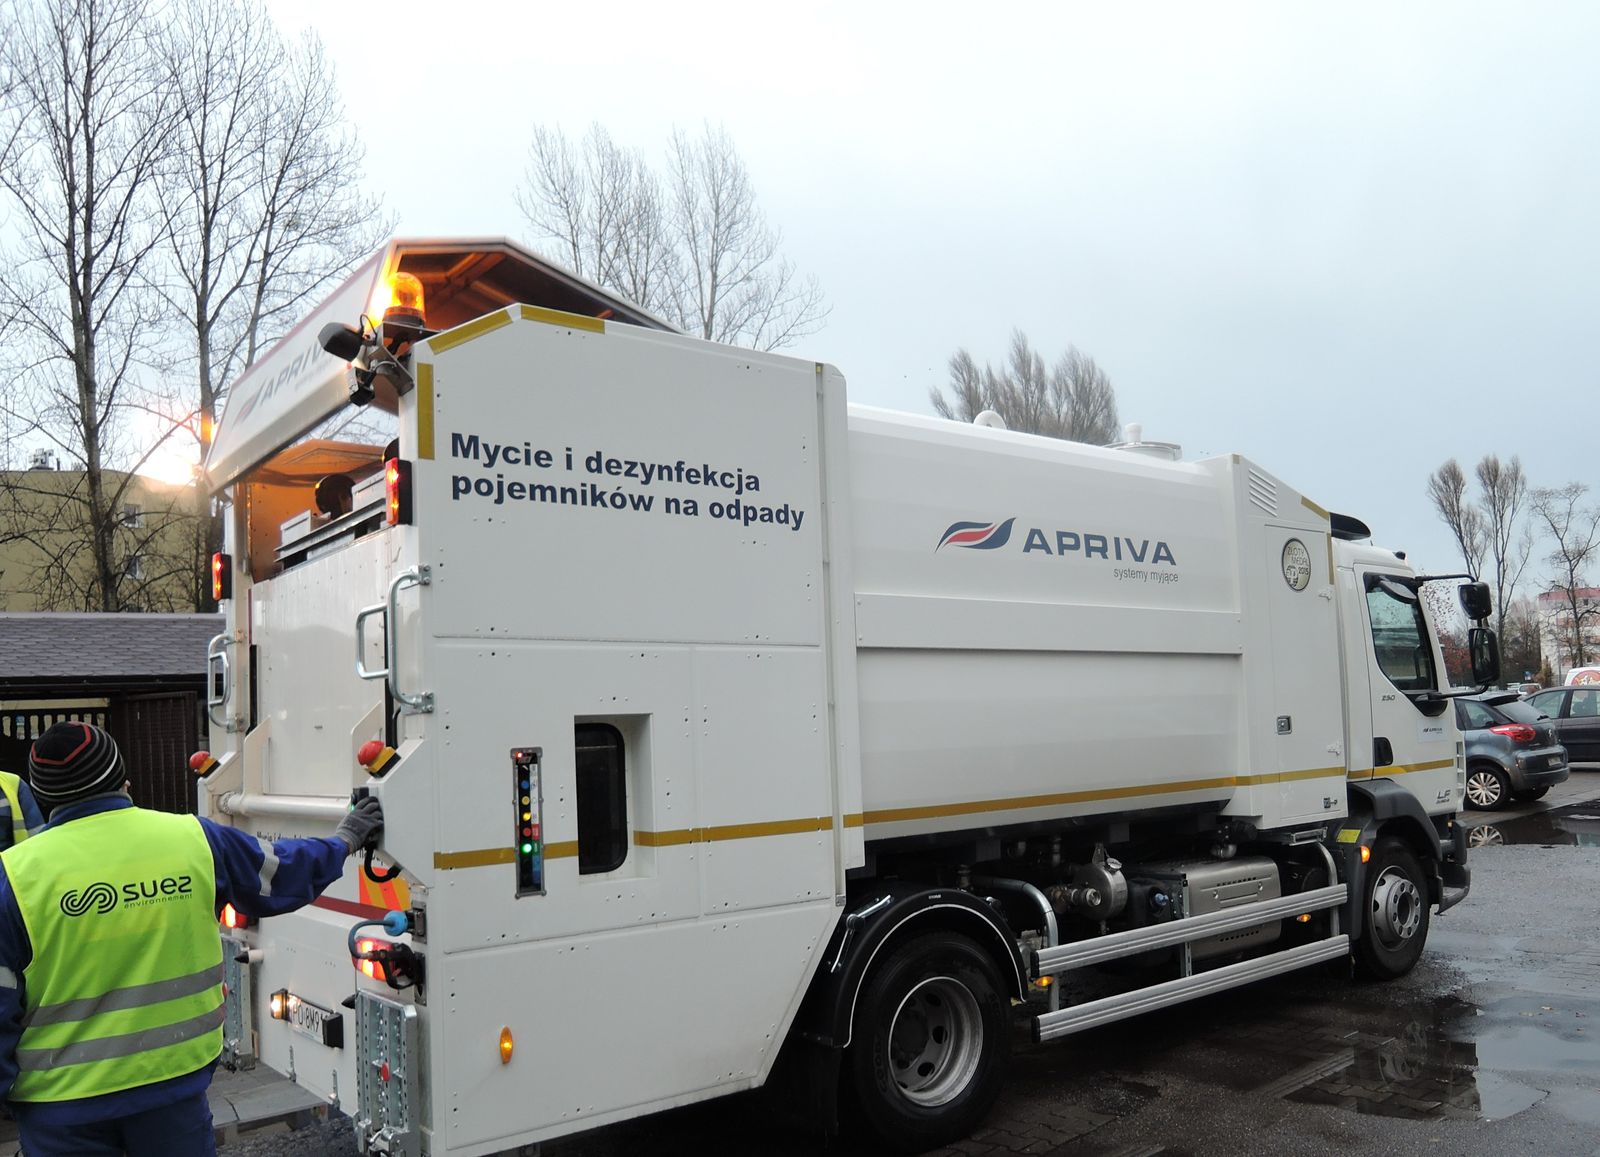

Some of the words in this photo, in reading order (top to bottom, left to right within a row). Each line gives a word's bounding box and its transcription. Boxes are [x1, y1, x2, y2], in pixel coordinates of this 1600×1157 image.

[452, 433, 553, 469] Mycie
[565, 446, 574, 471] i
[584, 450, 760, 493] dezynfekcja
[452, 474, 655, 512] pojemników
[664, 497, 699, 517] na
[708, 498, 805, 532] odpady
[1023, 527, 1177, 567] APRIVA
[1113, 567, 1149, 583] systemy
[1150, 570, 1180, 586] myjące
[1437, 789, 1452, 800] LF
[123, 875, 193, 902] suez
[124, 893, 193, 909] environnement
